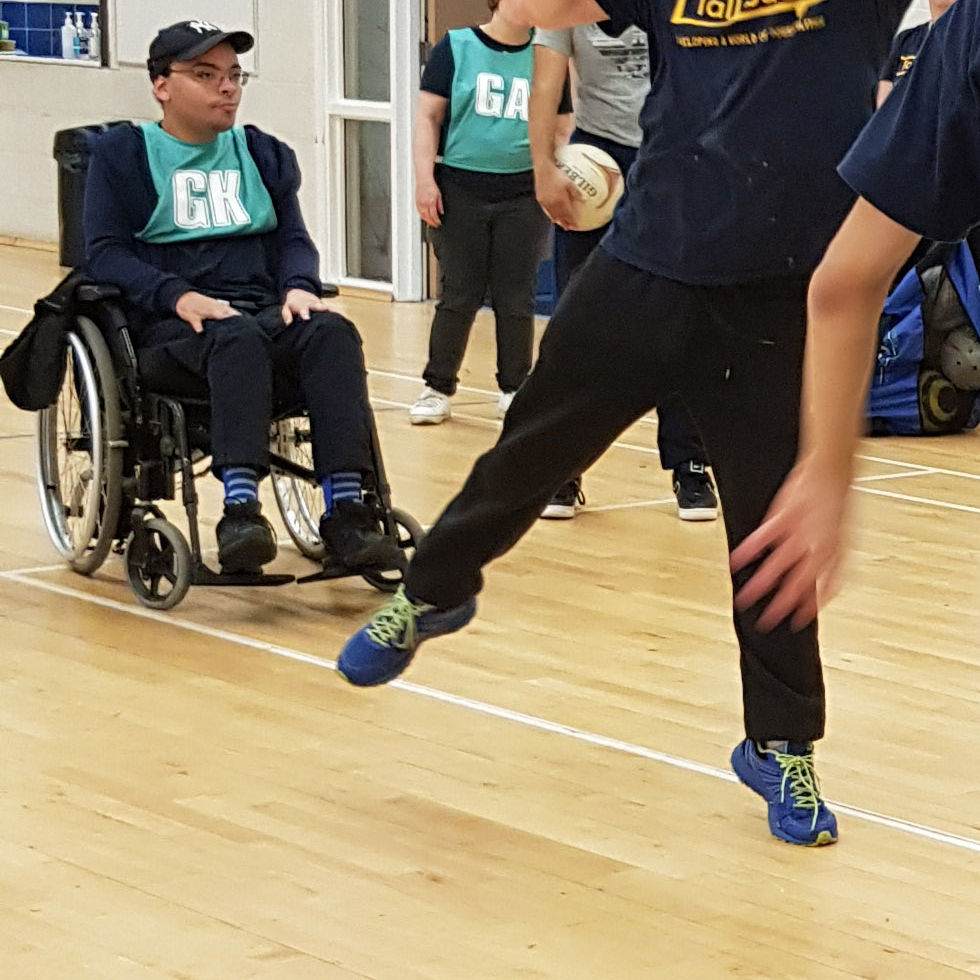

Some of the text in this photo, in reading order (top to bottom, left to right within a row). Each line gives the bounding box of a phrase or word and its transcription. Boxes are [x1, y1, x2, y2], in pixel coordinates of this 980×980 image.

[475, 72, 530, 122] GA
[172, 169, 251, 230] GK
[556, 159, 598, 197] GILBER
